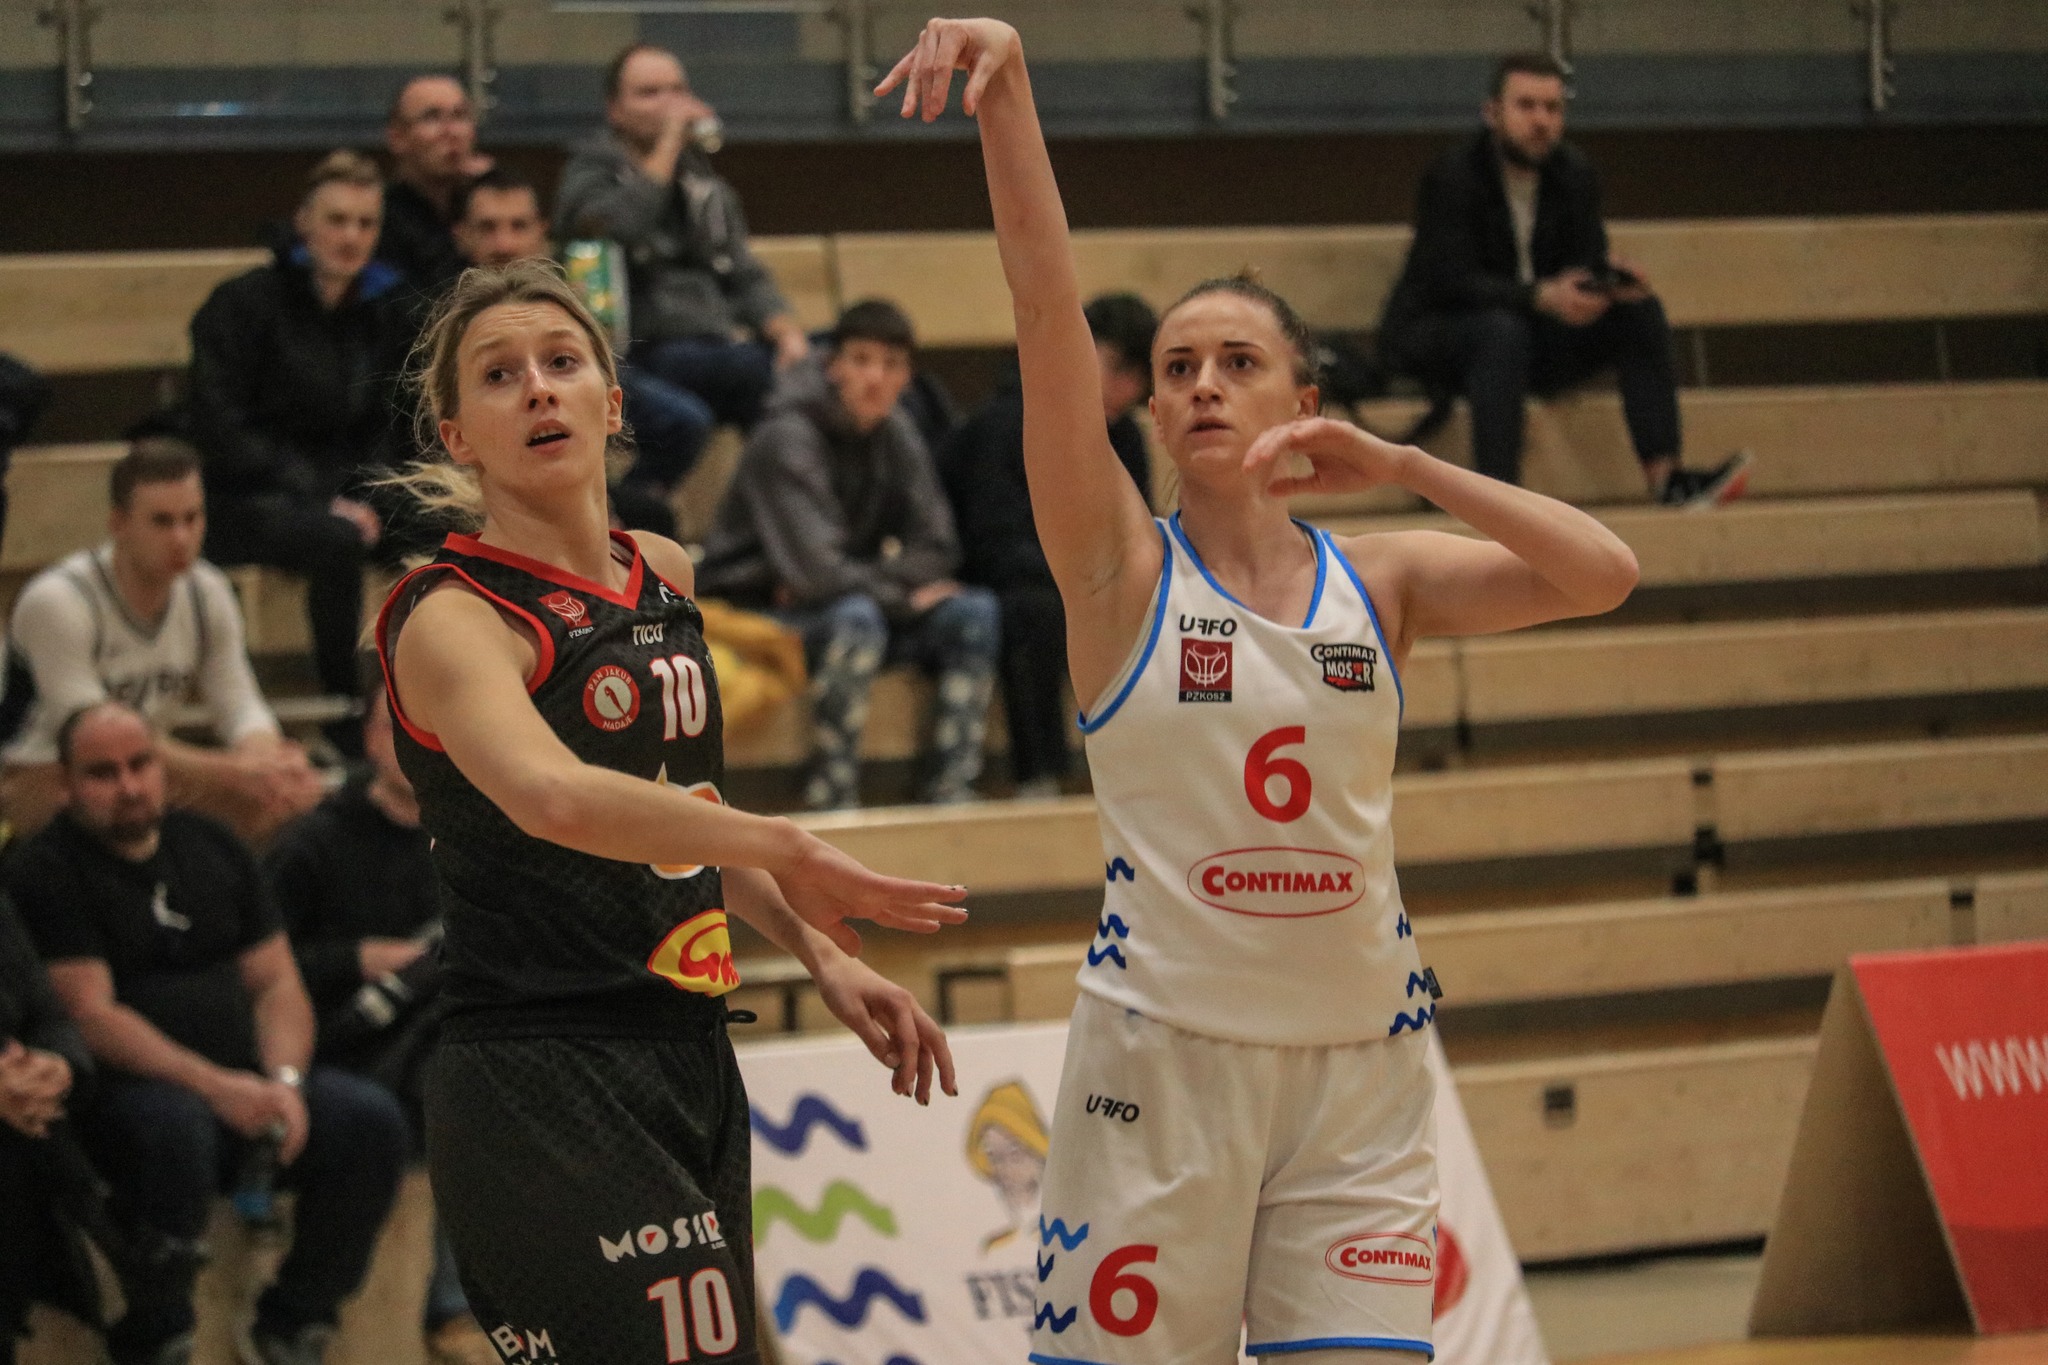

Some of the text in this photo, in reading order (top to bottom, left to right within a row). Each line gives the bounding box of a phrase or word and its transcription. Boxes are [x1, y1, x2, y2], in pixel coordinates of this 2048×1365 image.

[632, 622, 664, 646] TICO
[587, 668, 632, 692] PAN JAKUB
[1186, 691, 1226, 701] PZKOSZ
[648, 653, 707, 741] 10
[1243, 725, 1312, 823] 6
[1201, 865, 1354, 897] CONTIMAX
[1340, 1246, 1431, 1272] CONTIMAX
[1088, 1244, 1159, 1338] 6
[647, 1267, 738, 1365] 10
